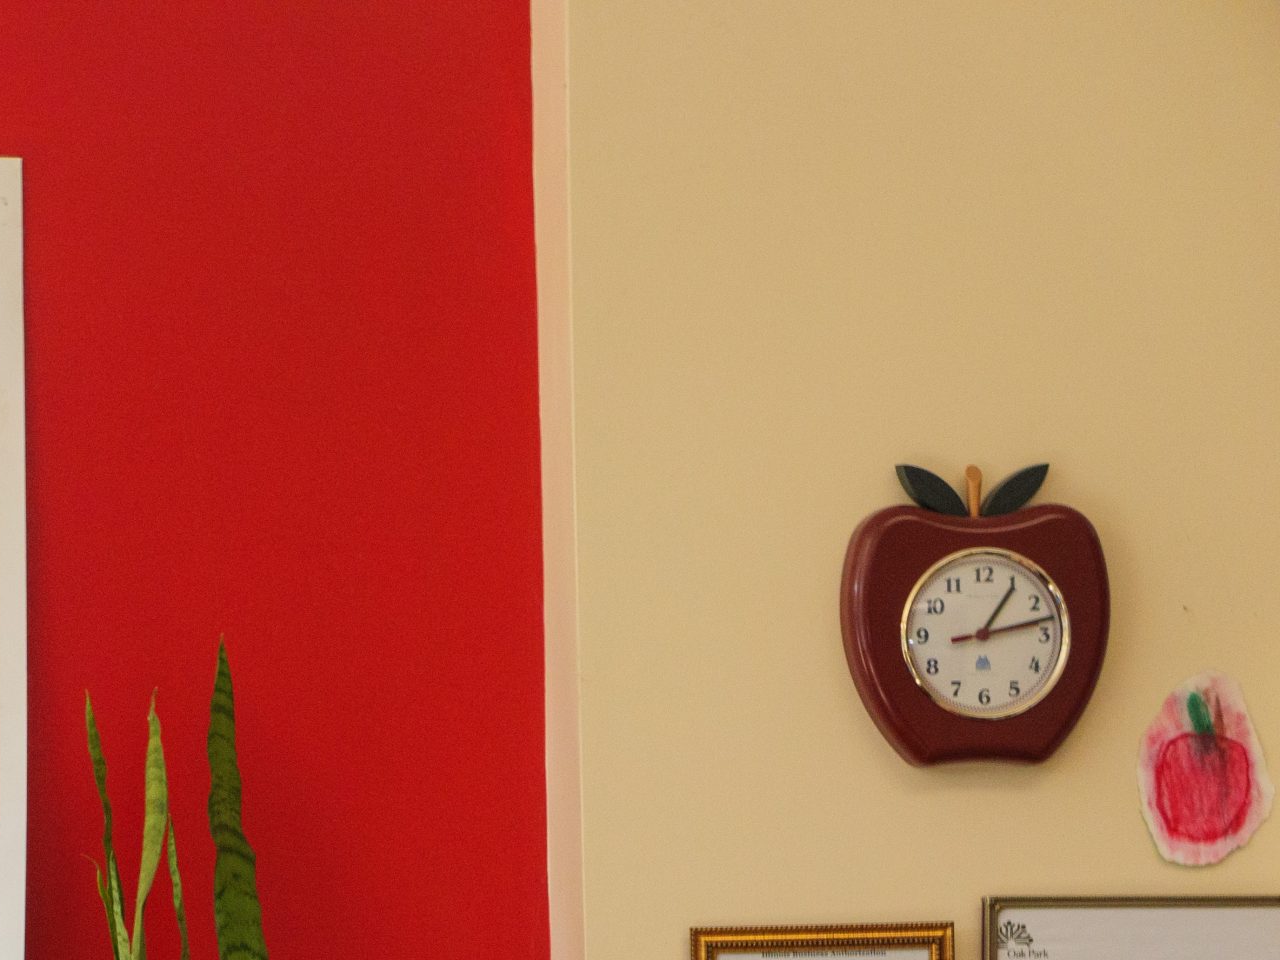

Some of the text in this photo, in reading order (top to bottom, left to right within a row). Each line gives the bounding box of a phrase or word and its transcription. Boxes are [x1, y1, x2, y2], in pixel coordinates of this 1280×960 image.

[975, 566, 994, 583] 12
[945, 578, 962, 593] 11
[926, 599, 945, 615] 10
[1029, 595, 1041, 611] 2
[916, 628, 929, 644] 9
[1038, 627, 1050, 643] 3
[926, 658, 939, 674] 8
[1029, 656, 1040, 673] 4
[950, 681, 962, 697] 7
[978, 688, 991, 705] 6
[1009, 681, 1021, 697] 5
[1007, 949, 1049, 959] Oak Park
